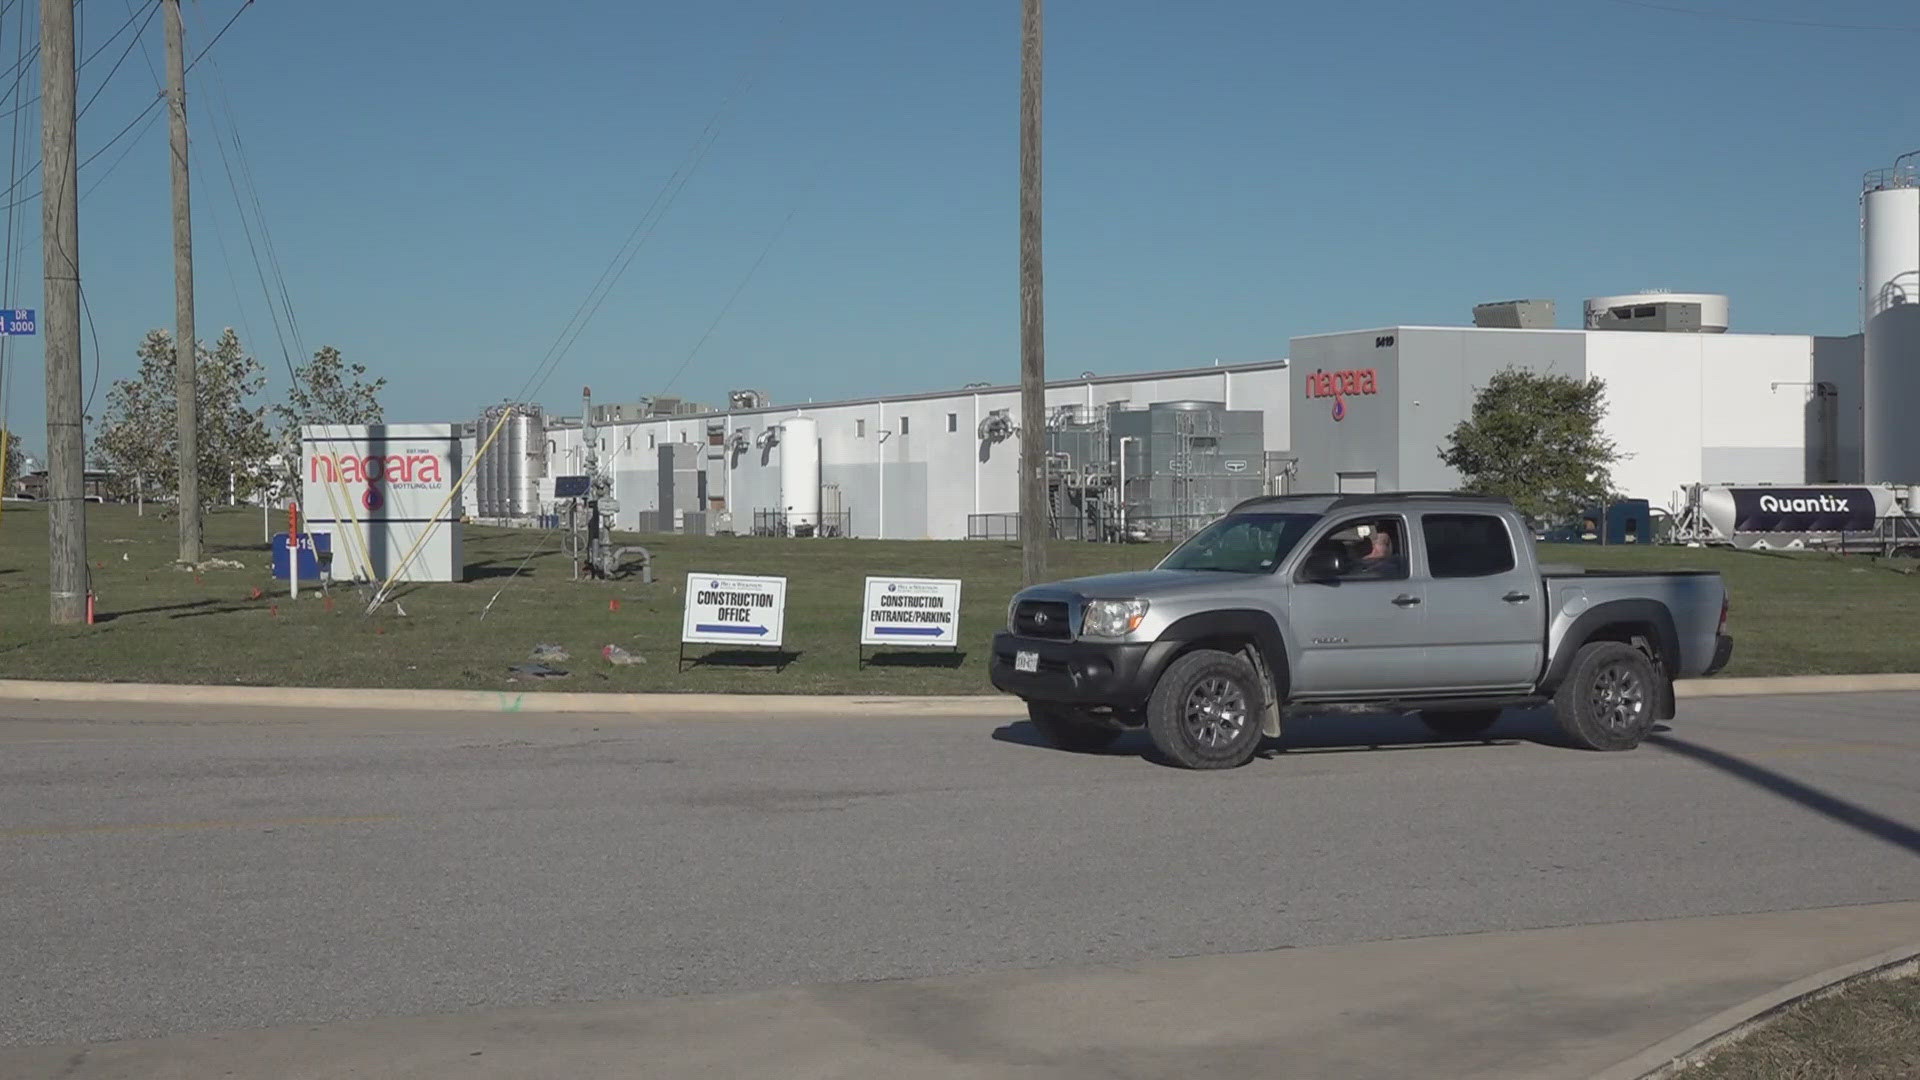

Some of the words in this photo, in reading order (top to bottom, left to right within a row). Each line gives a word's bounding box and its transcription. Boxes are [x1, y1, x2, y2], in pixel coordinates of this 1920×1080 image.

[15, 310, 28, 320] DR
[10, 321, 35, 332] 3000
[1760, 495, 1849, 512] Quantix
[697, 590, 774, 608] CONSTRUCTION
[880, 595, 944, 608] CONSTRUCTION
[717, 607, 751, 622] OFFICE
[870, 610, 951, 624] ENTRANCE/PARKING
